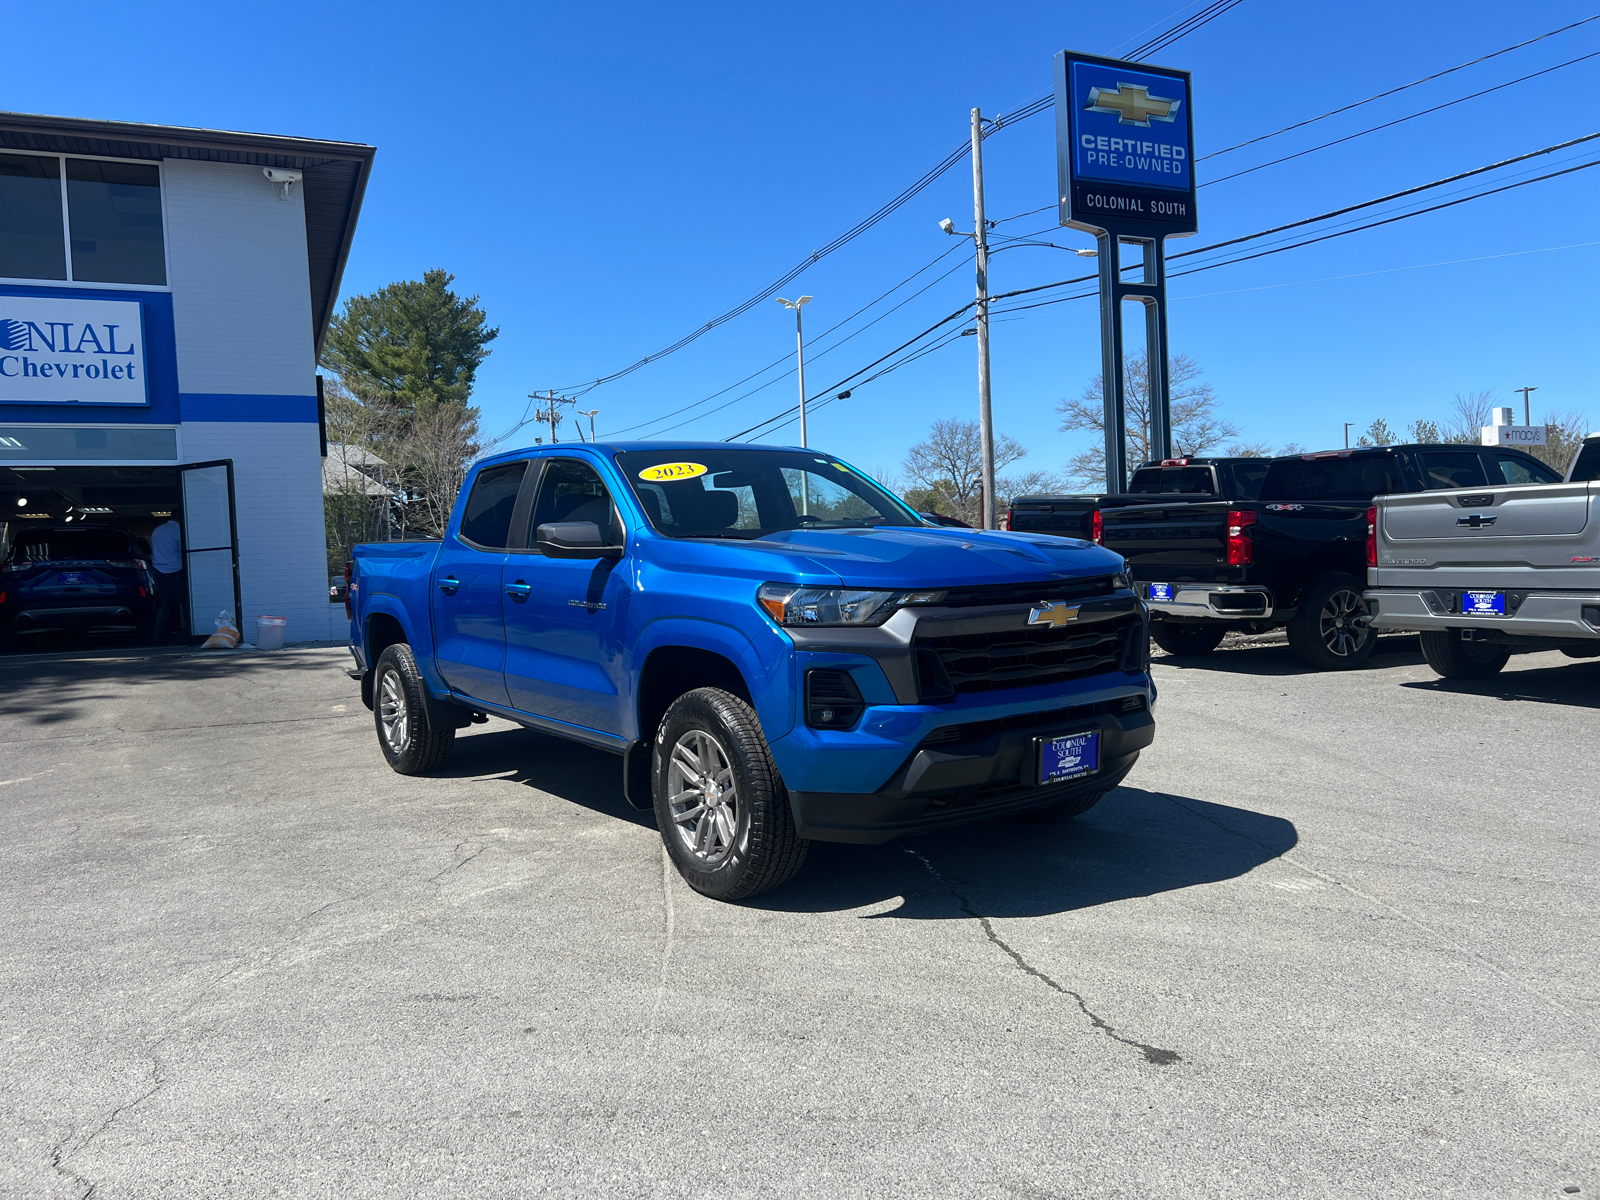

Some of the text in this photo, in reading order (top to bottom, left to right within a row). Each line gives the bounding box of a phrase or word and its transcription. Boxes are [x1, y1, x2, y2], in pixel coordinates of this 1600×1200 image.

[1081, 134, 1186, 160] CERTIFIED
[1087, 151, 1182, 174] PRE-OWNED
[1086, 193, 1186, 216] COLONIAL SOUTH
[0, 355, 136, 380] Chevrolet
[1511, 428, 1540, 443] macy's
[652, 464, 694, 479] 2023
[1052, 737, 1087, 751] COLONIAL
[1057, 746, 1082, 758] SOUTH
